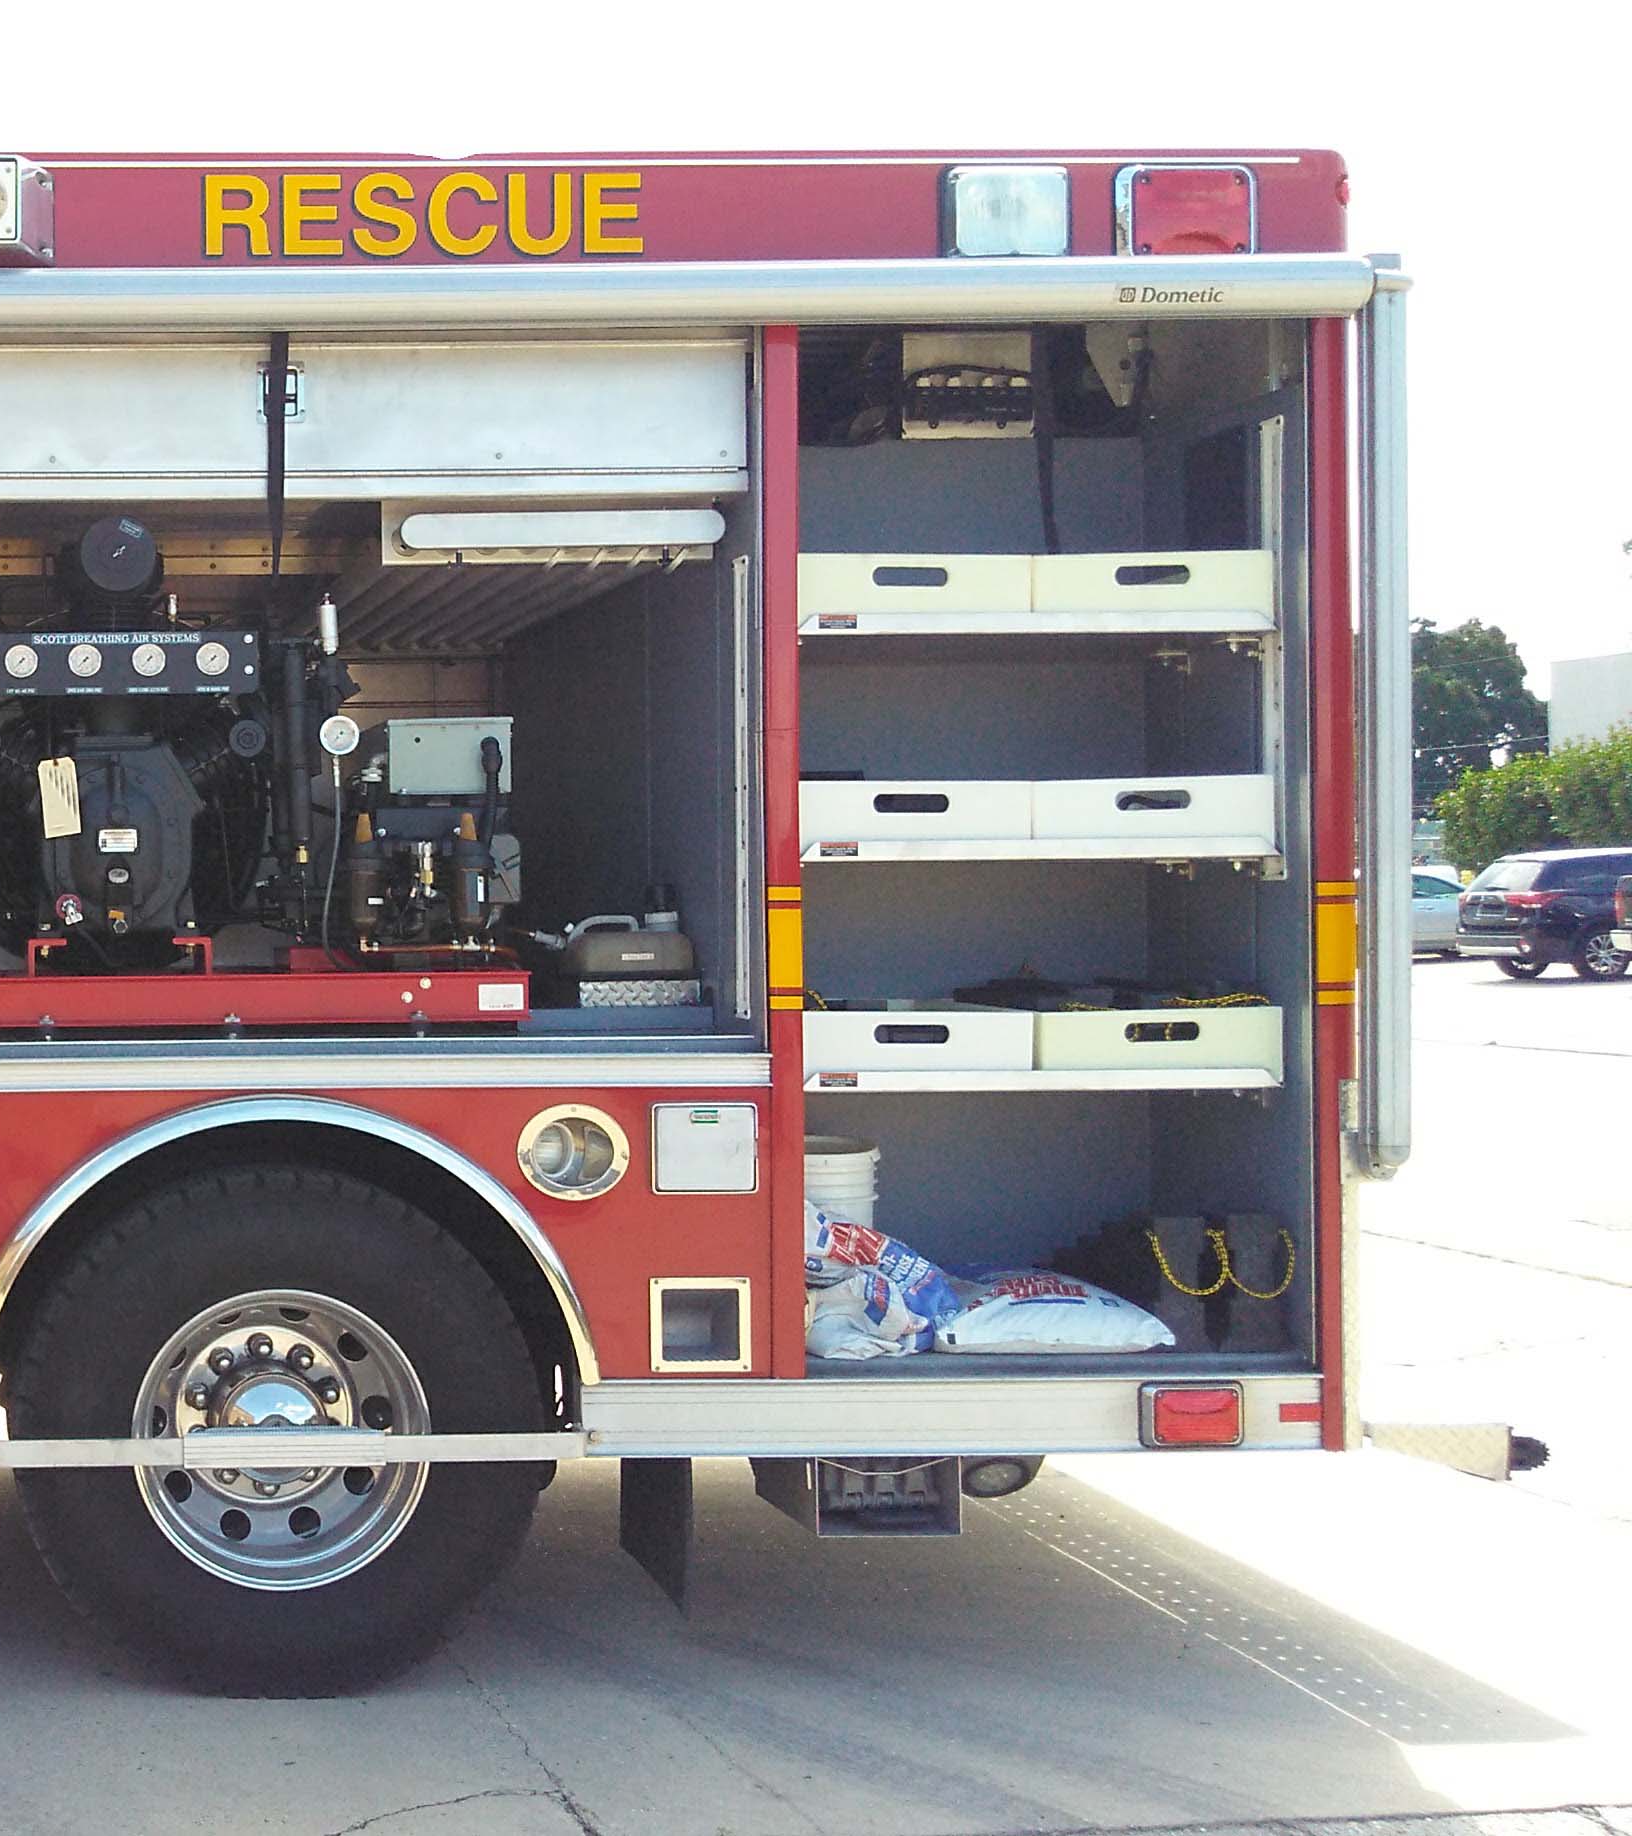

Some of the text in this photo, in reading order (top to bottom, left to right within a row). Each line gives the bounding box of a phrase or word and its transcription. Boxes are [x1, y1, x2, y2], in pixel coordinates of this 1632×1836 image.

[204, 172, 644, 257] RESCUE
[1142, 287, 1224, 303] Dometic
[33, 633, 200, 645] SCOTT BREATHING AIR SYSTEMS
